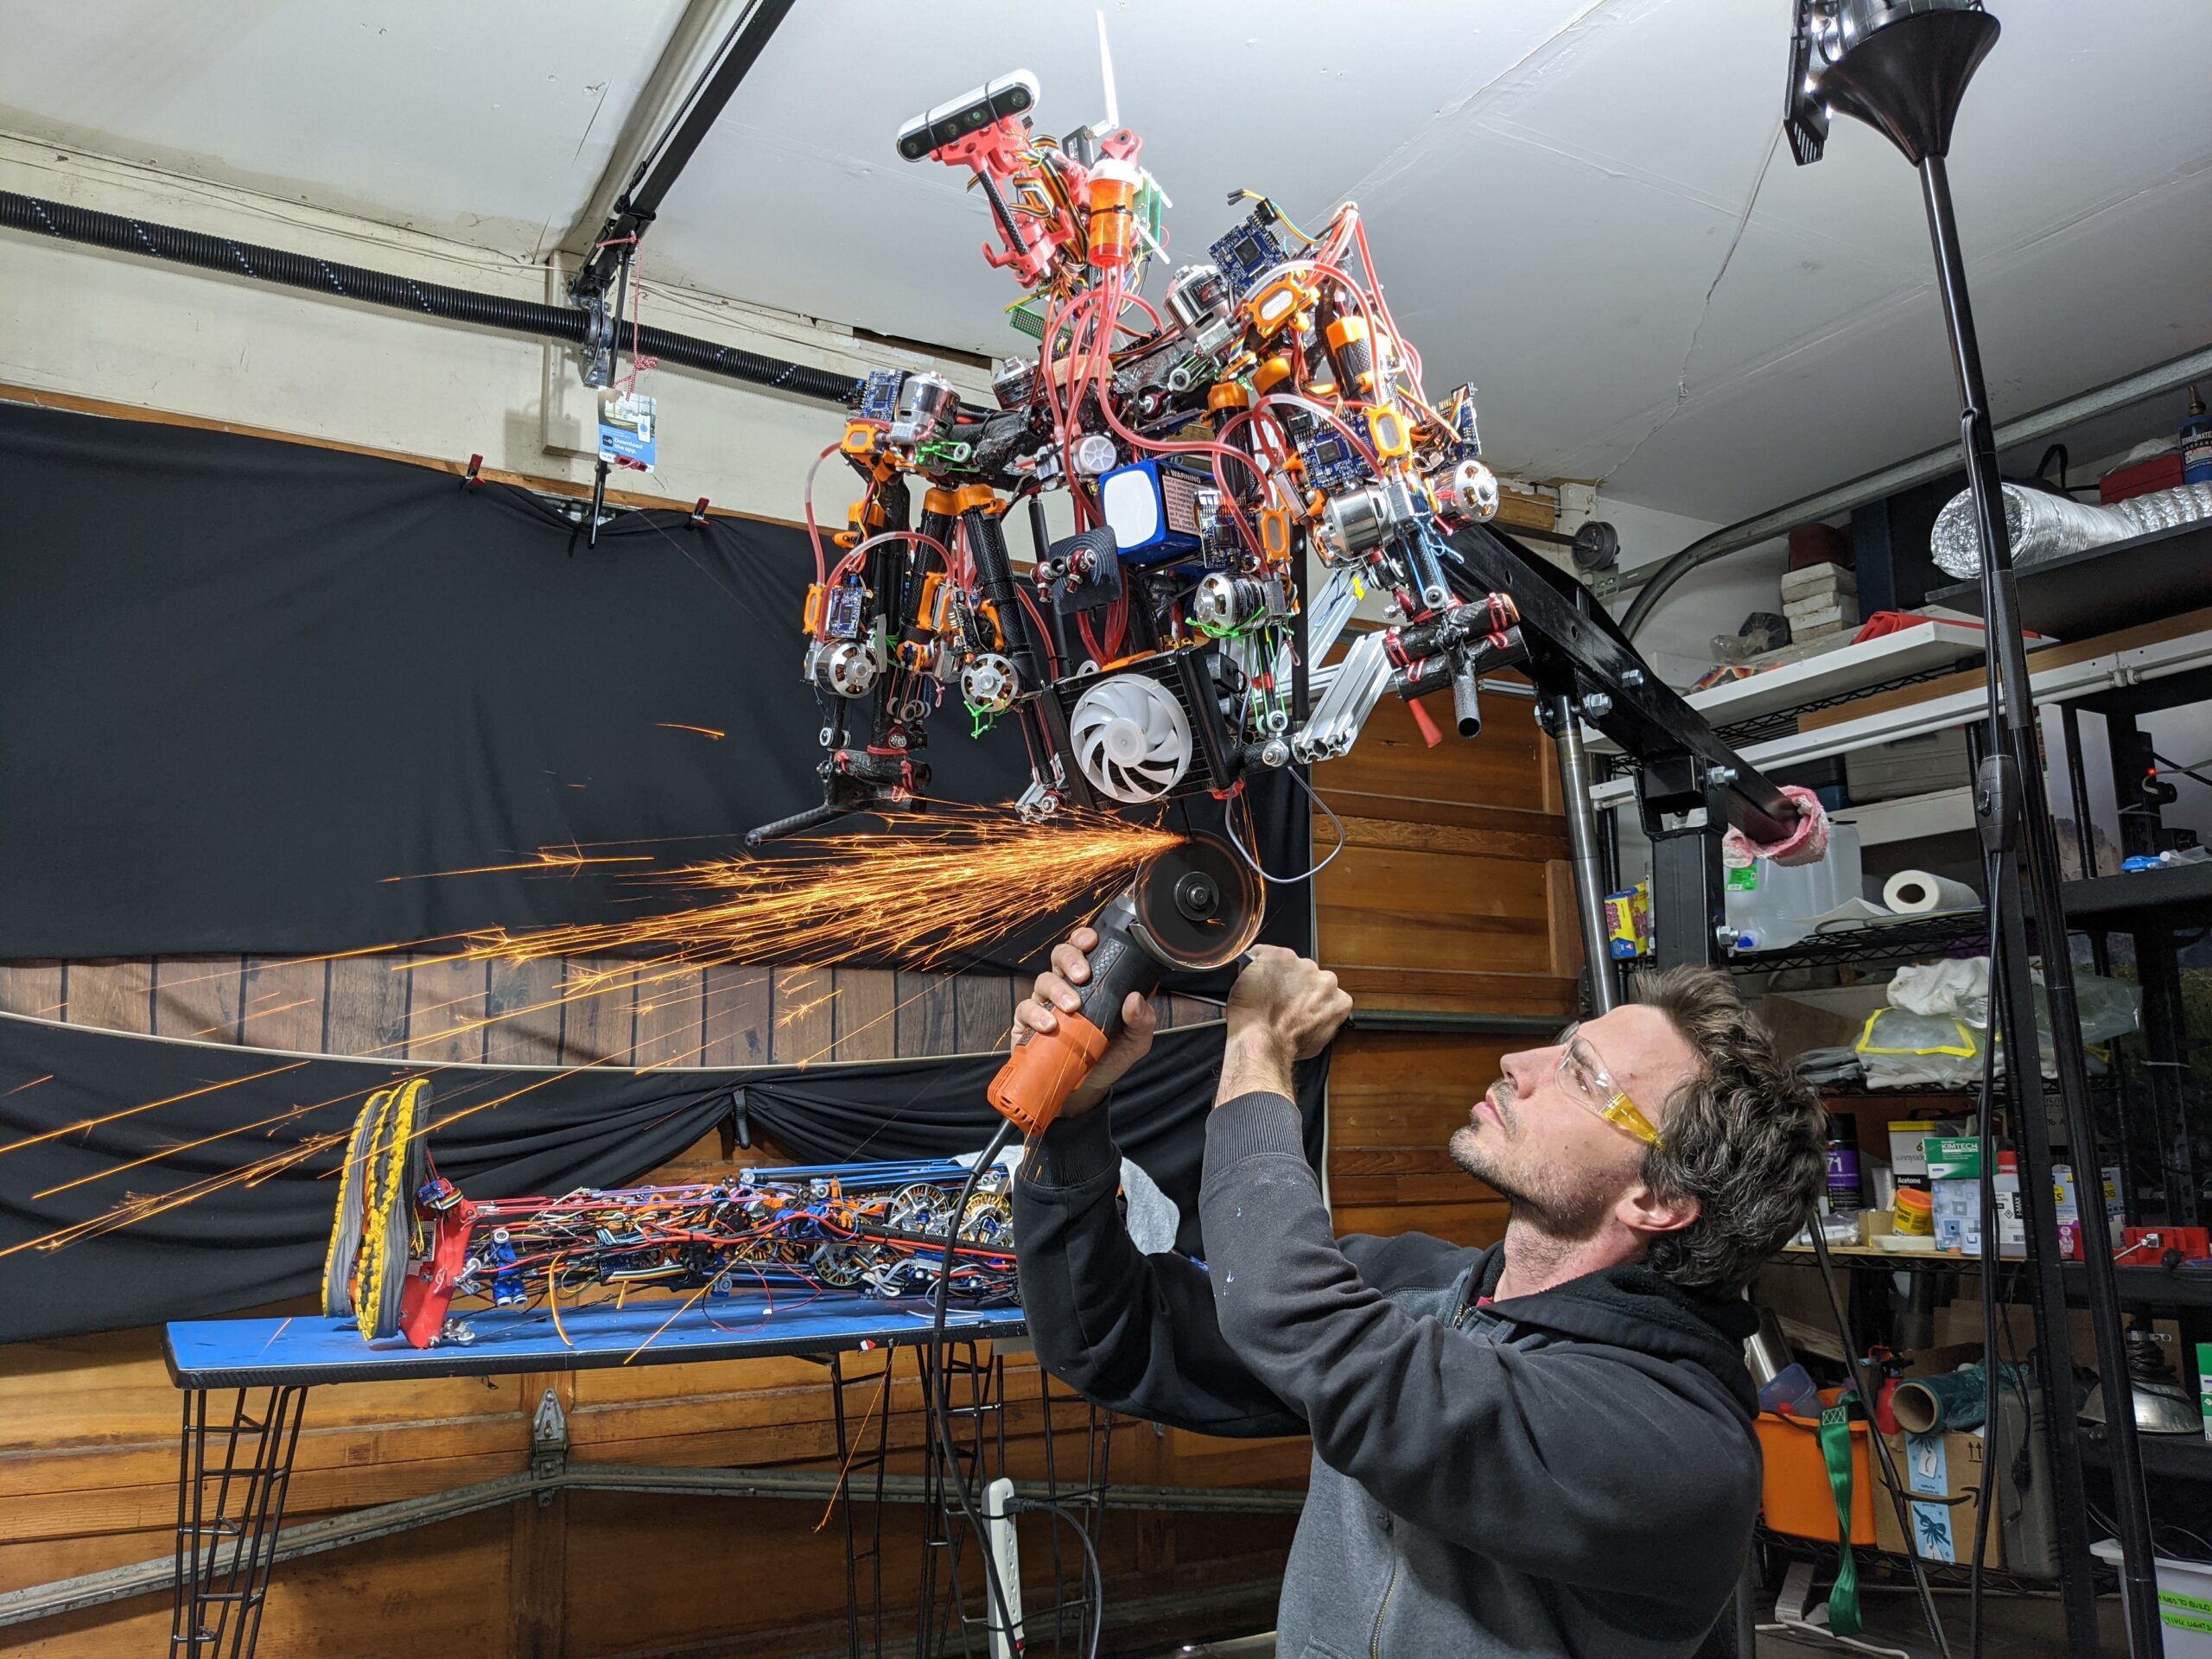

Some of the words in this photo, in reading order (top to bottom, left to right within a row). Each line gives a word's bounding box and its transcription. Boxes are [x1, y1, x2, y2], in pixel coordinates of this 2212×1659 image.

[614, 437, 643, 449] Download
[1171, 469, 1201, 484] WARNING
[2189, 1601, 2211, 1611] BUILD
